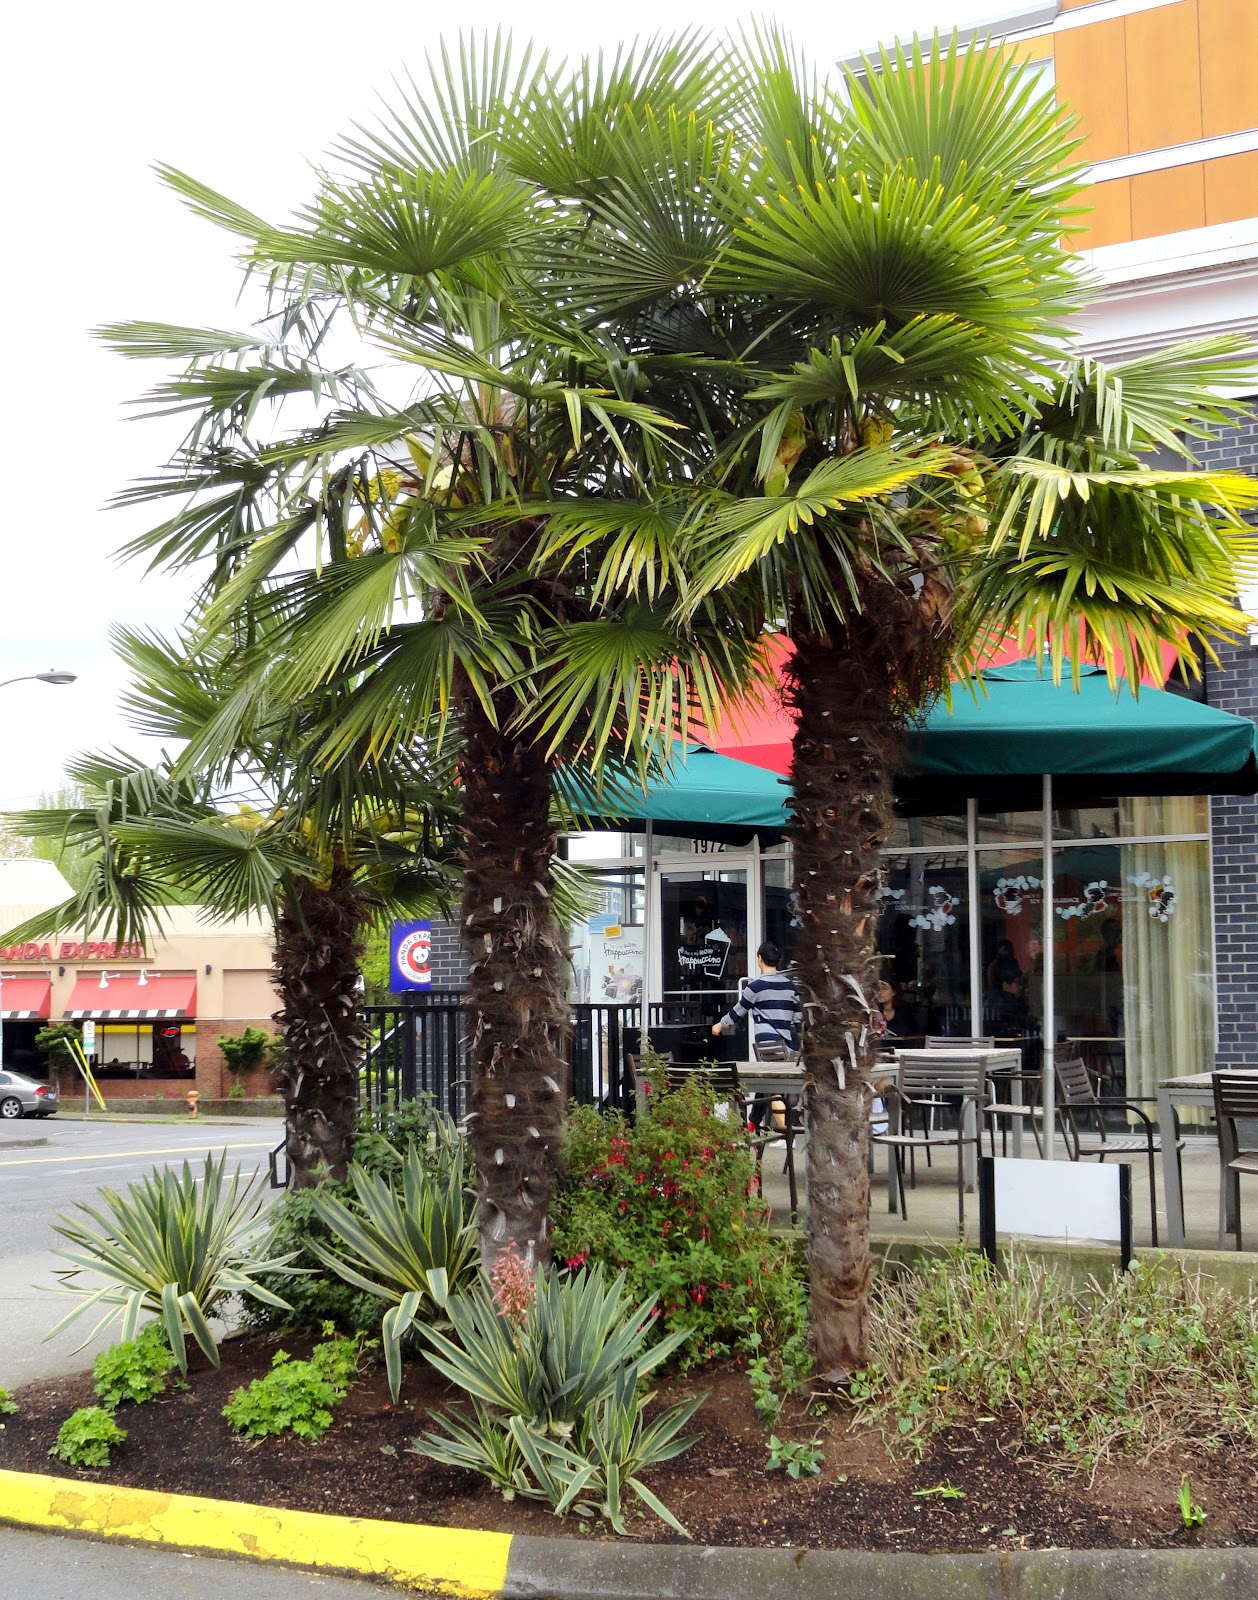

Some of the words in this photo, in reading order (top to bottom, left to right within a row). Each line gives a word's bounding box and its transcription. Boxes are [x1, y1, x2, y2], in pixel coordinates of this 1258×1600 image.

[693, 839, 725, 853] 1972
[401, 940, 412, 965] PANDA
[603, 942, 644, 960] frappuccino
[677, 948, 722, 970] frappuccino
